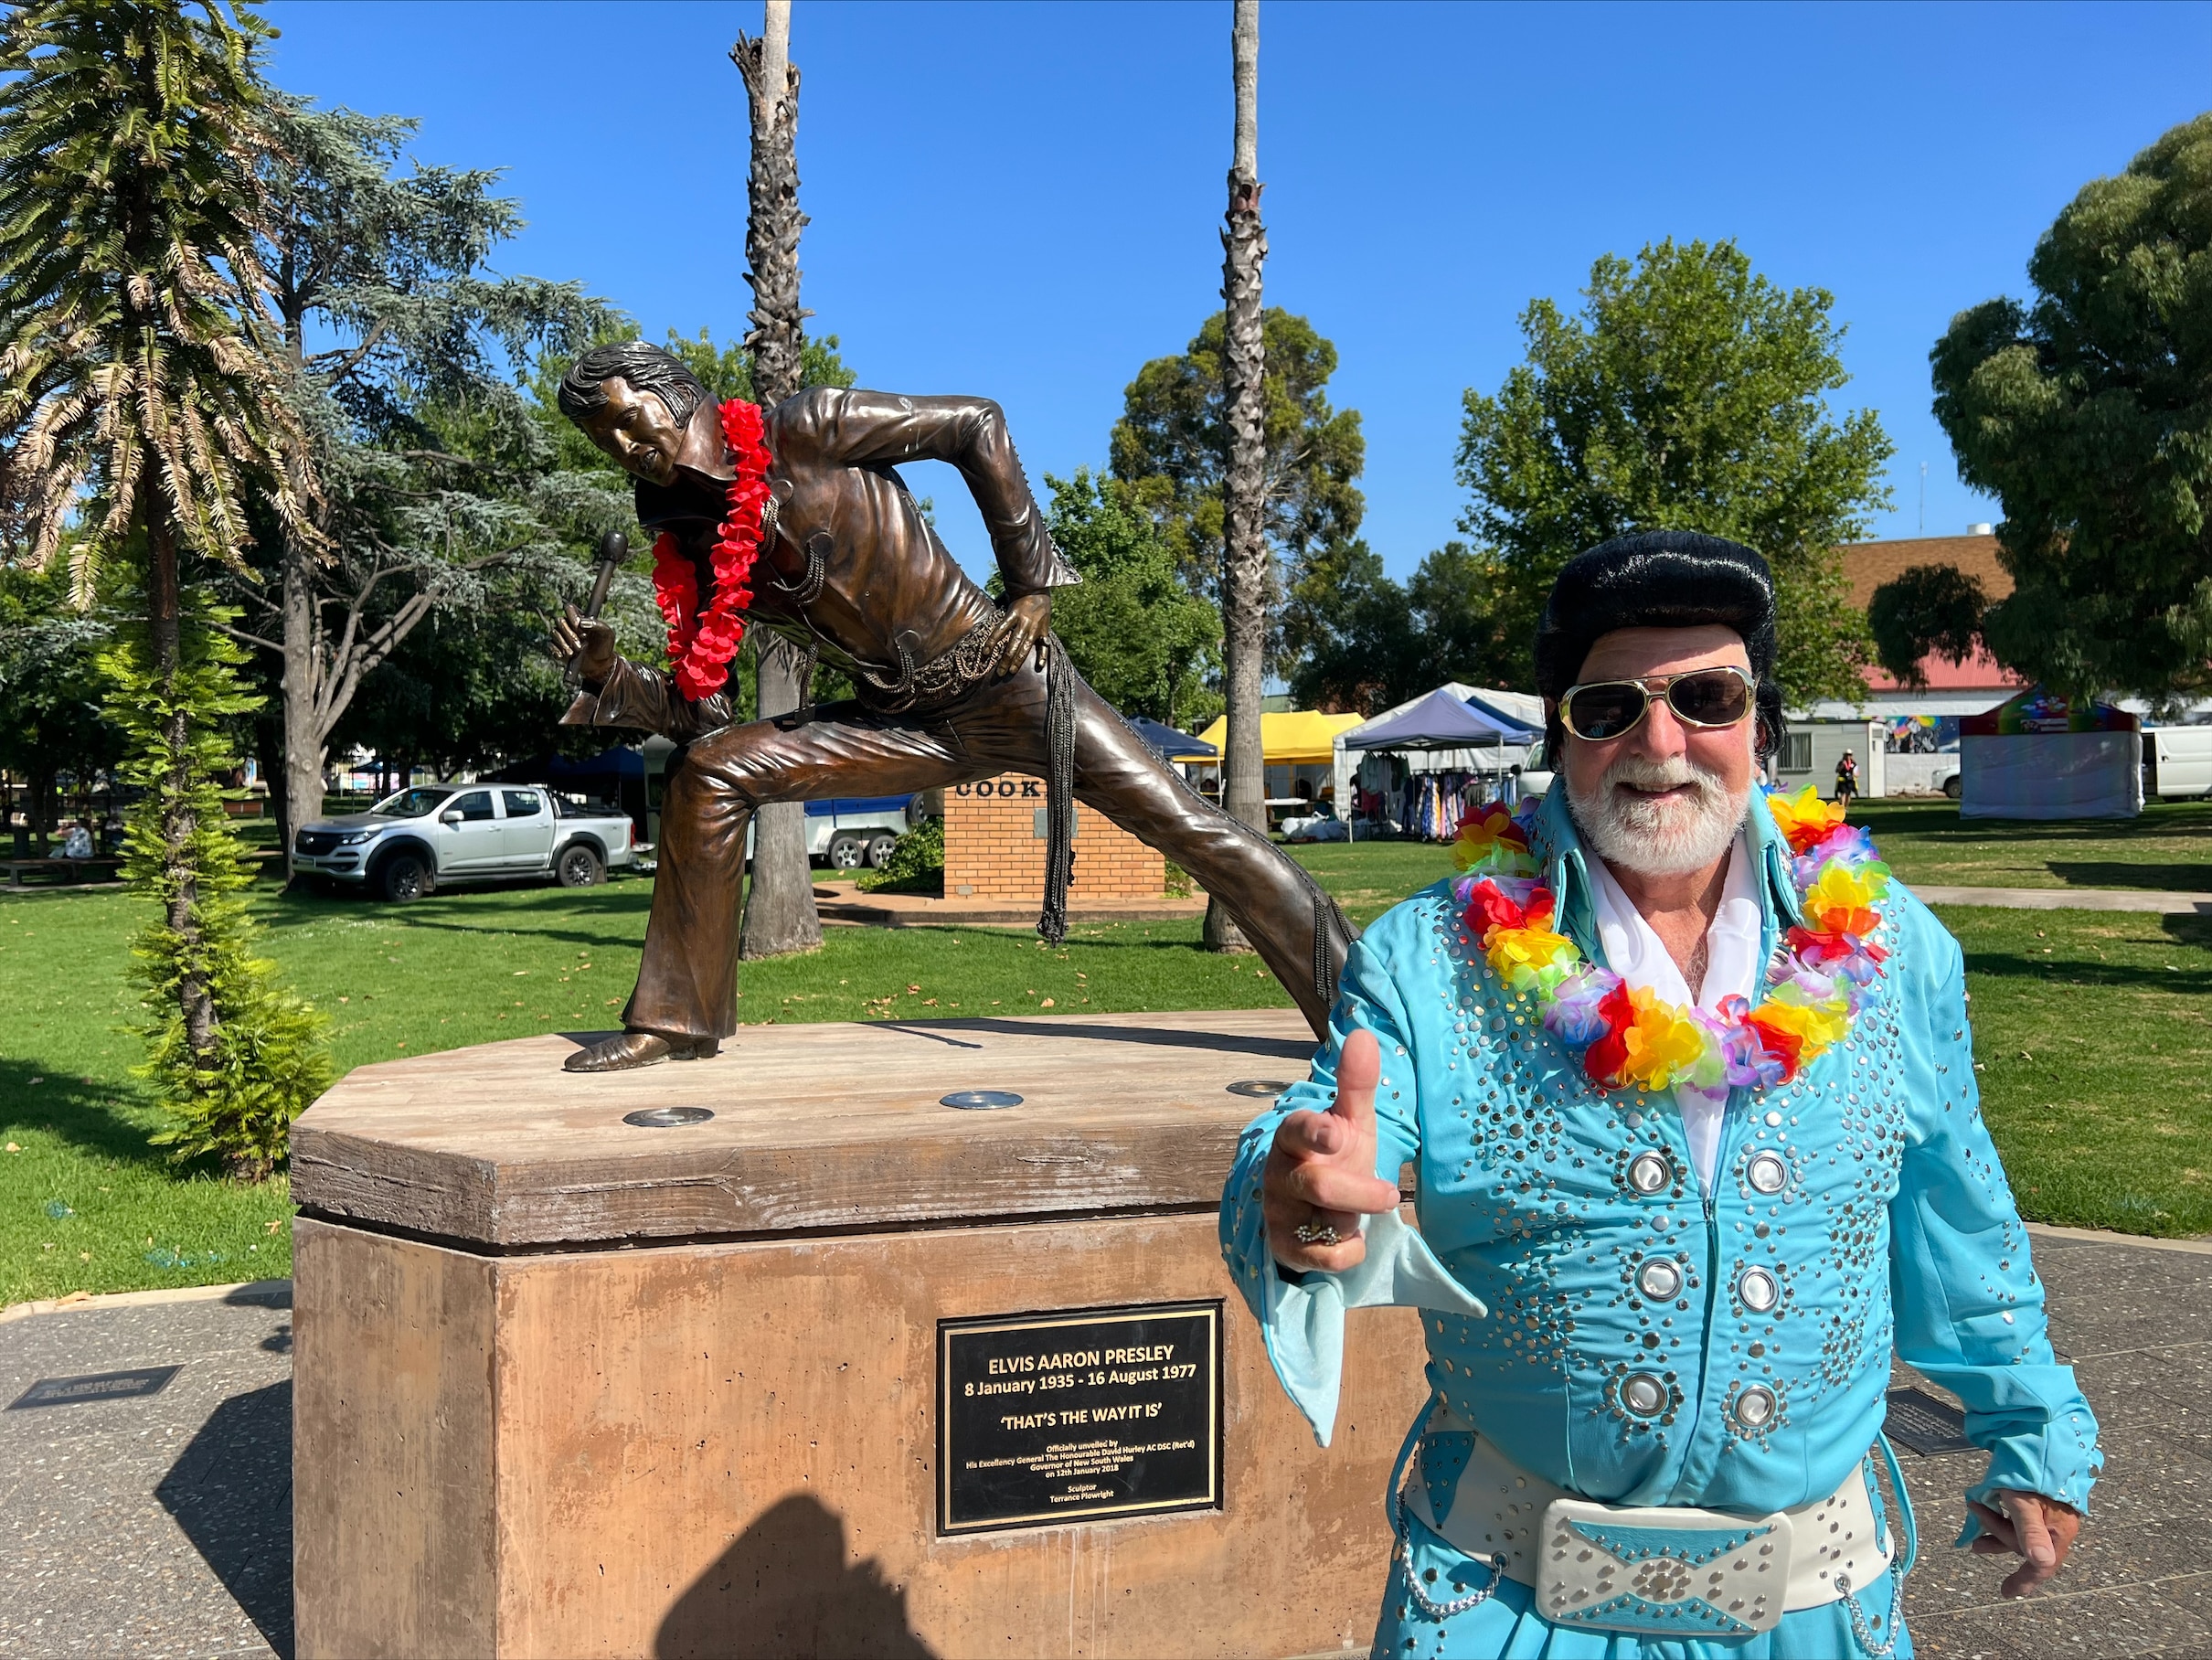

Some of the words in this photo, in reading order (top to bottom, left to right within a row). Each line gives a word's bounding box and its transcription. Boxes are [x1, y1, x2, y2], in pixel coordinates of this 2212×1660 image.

[956, 781, 1048, 797] COOK
[988, 1356, 1035, 1375] ELVIS
[1037, 1350, 1101, 1371] AARON
[1104, 1344, 1175, 1366] PRESLEY
[963, 1382, 975, 1397] 8
[976, 1379, 1036, 1396] January
[1038, 1374, 1075, 1390] 1935
[1087, 1371, 1106, 1386] 16
[1108, 1367, 1159, 1386] August
[1161, 1363, 1197, 1380] 1977
[1058, 1409, 1089, 1426] THE
[1091, 1406, 1127, 1422] WAY
[1128, 1404, 1143, 1420] IT
[1046, 1443, 1077, 1452] Officially
[1078, 1441, 1108, 1450] unveiled
[1109, 1439, 1119, 1448] by
[965, 1461, 978, 1470] His
[978, 1458, 1016, 1468] Excellency
[1016, 1455, 1045, 1464] General
[1045, 1452, 1059, 1463] The
[1059, 1449, 1101, 1460] Honourable
[1101, 1446, 1122, 1456] David
[1122, 1445, 1146, 1454] Hurley
[1145, 1443, 1157, 1452] AC
[1157, 1442, 1172, 1451] DSC
[1029, 1463, 1064, 1472] Governor
[1064, 1461, 1074, 1469] of
[1073, 1458, 1090, 1467] New
[1090, 1455, 1112, 1466] South
[1112, 1454, 1134, 1463] Wales
[1056, 1468, 1073, 1478] 12th
[1073, 1466, 1101, 1475] January
[1101, 1463, 1120, 1474] 2018
[1049, 1495, 1080, 1504] Terrance
[1080, 1490, 1114, 1500] Plowright
[1068, 1484, 1097, 1494] Sculptor
